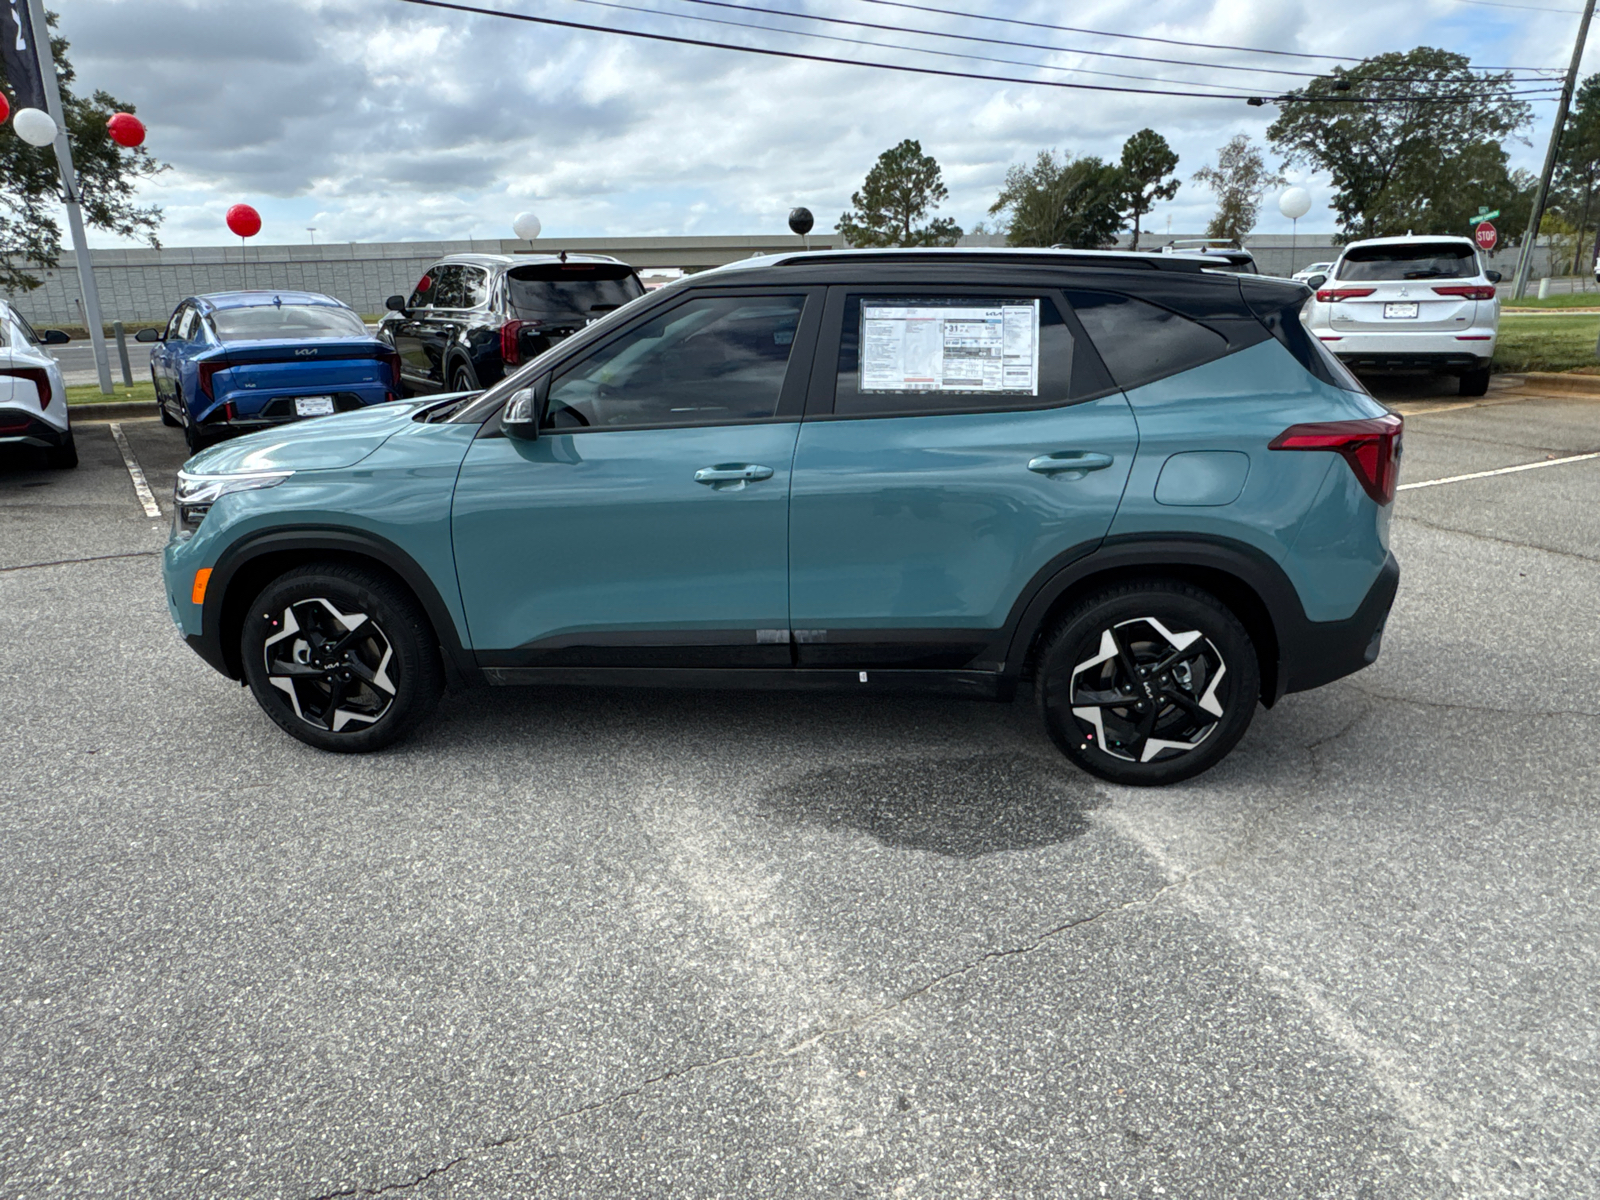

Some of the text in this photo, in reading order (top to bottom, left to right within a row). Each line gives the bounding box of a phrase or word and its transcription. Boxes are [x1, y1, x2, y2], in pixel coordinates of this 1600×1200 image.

[1477, 231, 1495, 241] STOP
[295, 348, 318, 356] KIA
[324, 662, 340, 670] KIA
